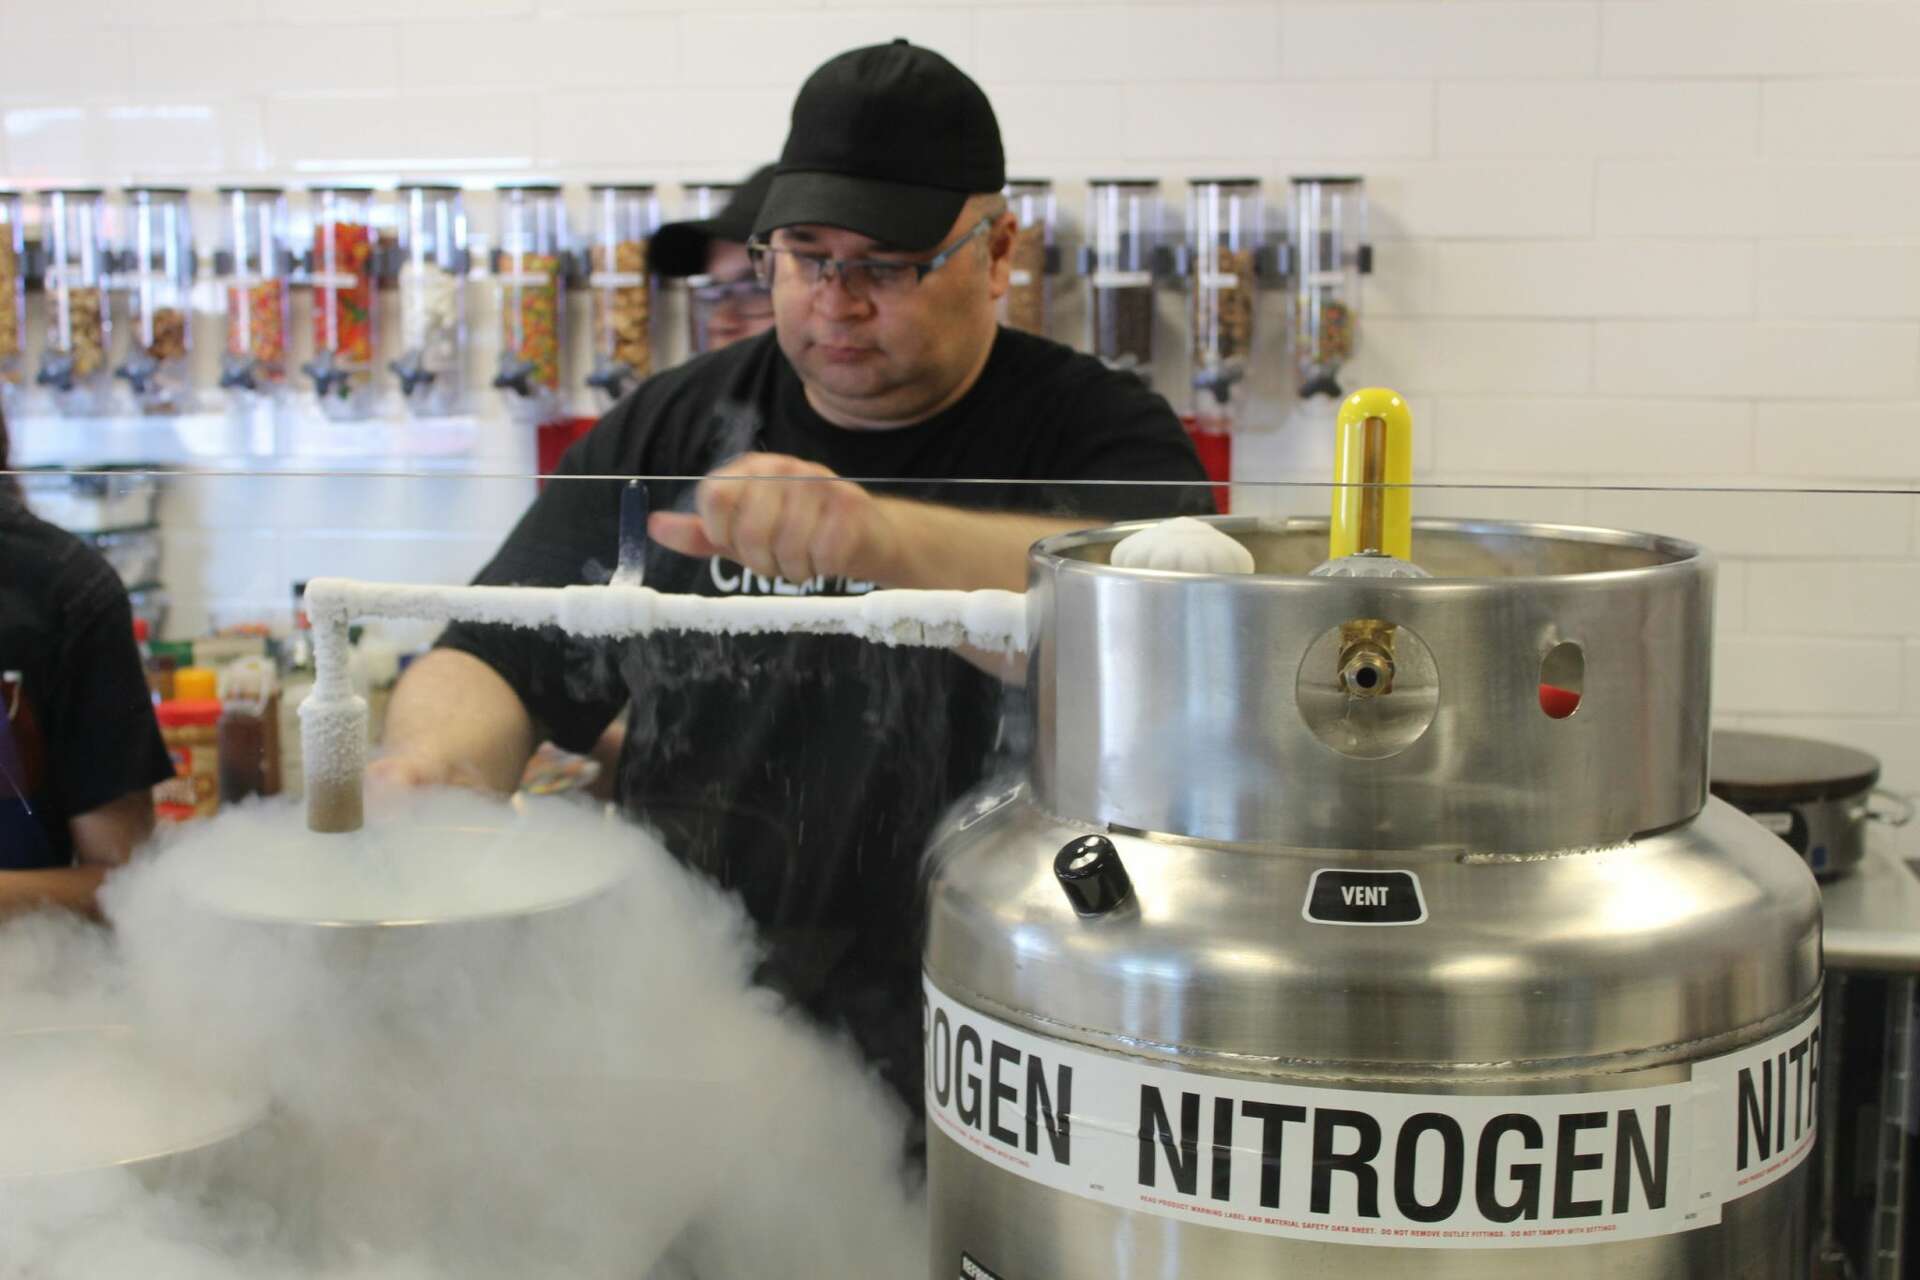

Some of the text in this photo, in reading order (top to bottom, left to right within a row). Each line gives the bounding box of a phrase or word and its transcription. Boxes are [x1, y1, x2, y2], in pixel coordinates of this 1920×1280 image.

[1341, 885, 1389, 906] VENT
[1138, 1084, 1671, 1223] NITROGEN
[1140, 1195, 1157, 1203] READ
[1158, 1199, 1189, 1210] PRODUCT
[1191, 1205, 1223, 1216] WARNING
[1224, 1211, 1246, 1221] LABEL
[1248, 1215, 1263, 1223] AND
[1264, 1217, 1301, 1228] MATERIAL
[1302, 1222, 1329, 1231] SAFETY
[1331, 1224, 1349, 1233] DATA
[1410, 1229, 1441, 1238] REMOVE
[1443, 1230, 1470, 1238] OUTLET
[1523, 1229, 1537, 1237] NOT
[1538, 1228, 1565, 1236] TAMPER
